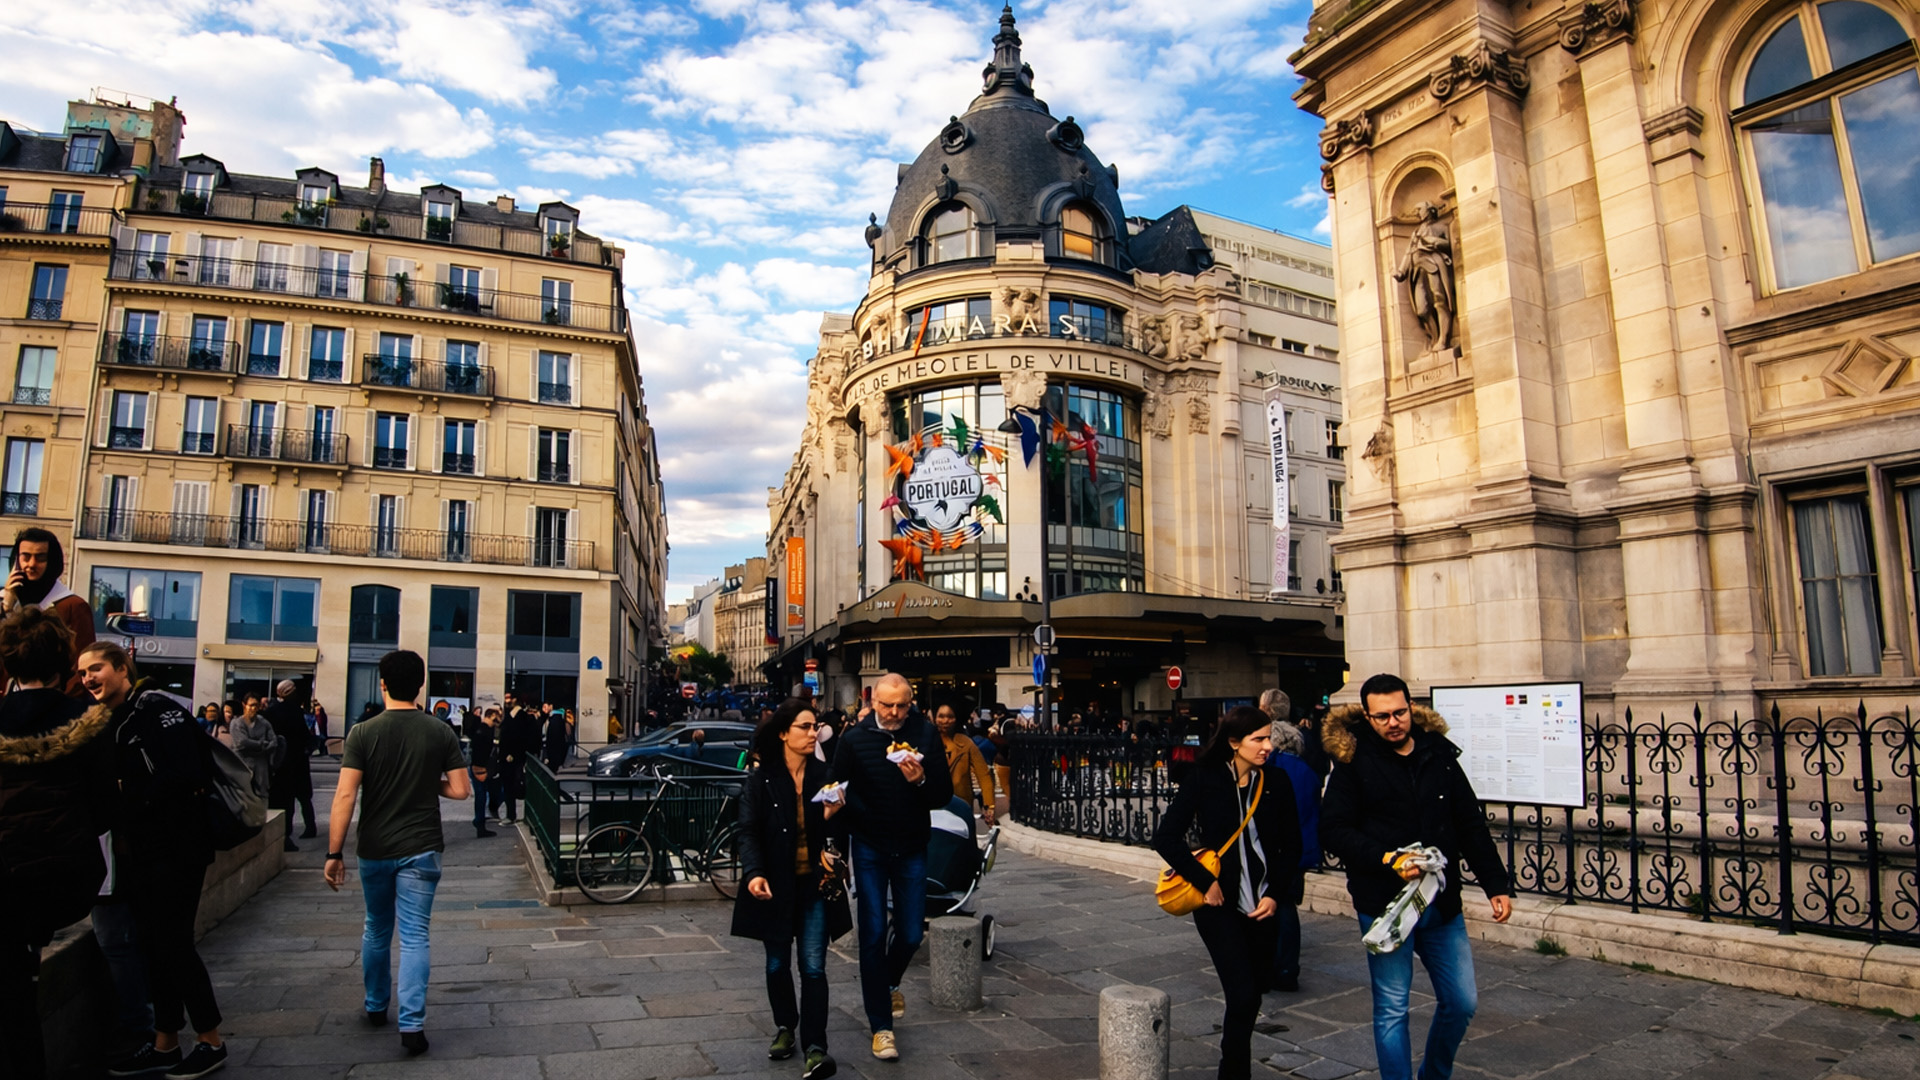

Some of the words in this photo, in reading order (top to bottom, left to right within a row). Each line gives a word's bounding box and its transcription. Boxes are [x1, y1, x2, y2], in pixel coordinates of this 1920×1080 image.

[928, 315, 1076, 345] MARAS
[1010, 355, 1035, 371] DE
[908, 477, 976, 501] PORTUGAL
